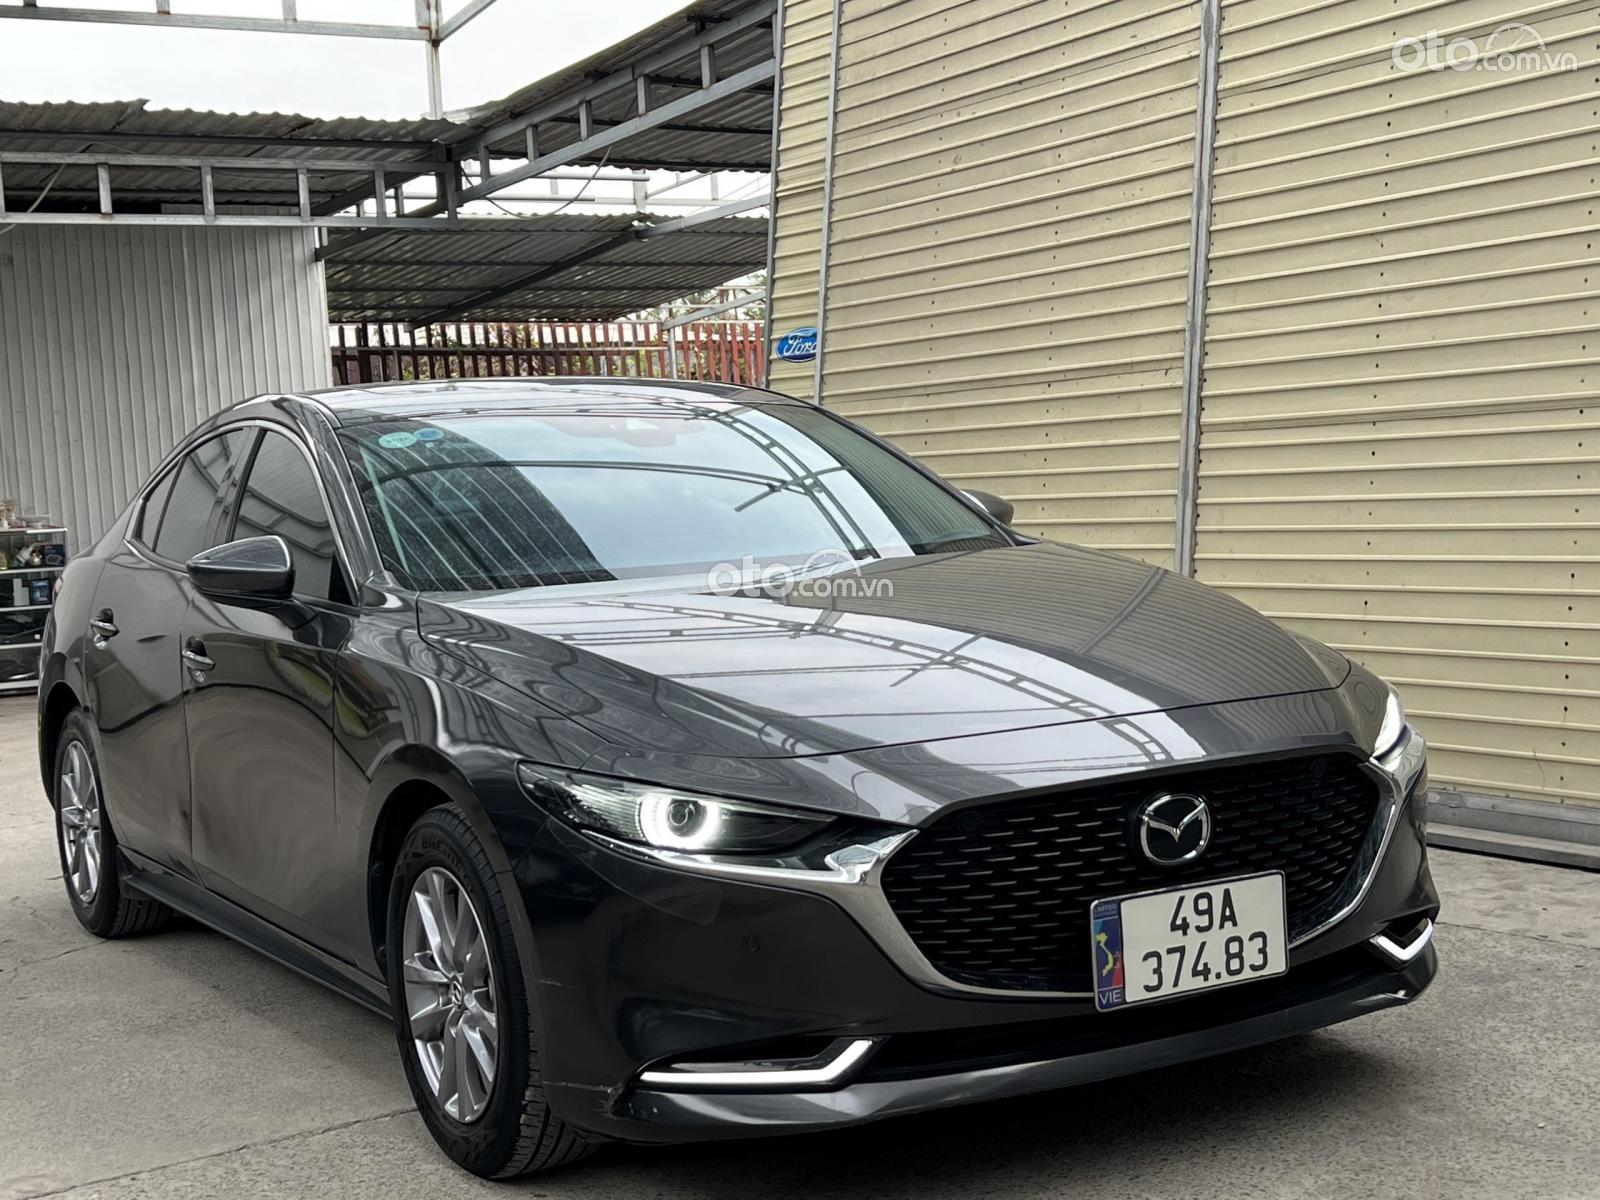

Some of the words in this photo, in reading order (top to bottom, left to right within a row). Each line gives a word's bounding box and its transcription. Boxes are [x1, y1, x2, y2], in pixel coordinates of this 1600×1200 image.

[1169, 887, 1239, 937] 49A
[1141, 930, 1269, 993] 374.83
[1098, 989, 1122, 1006] VIE
